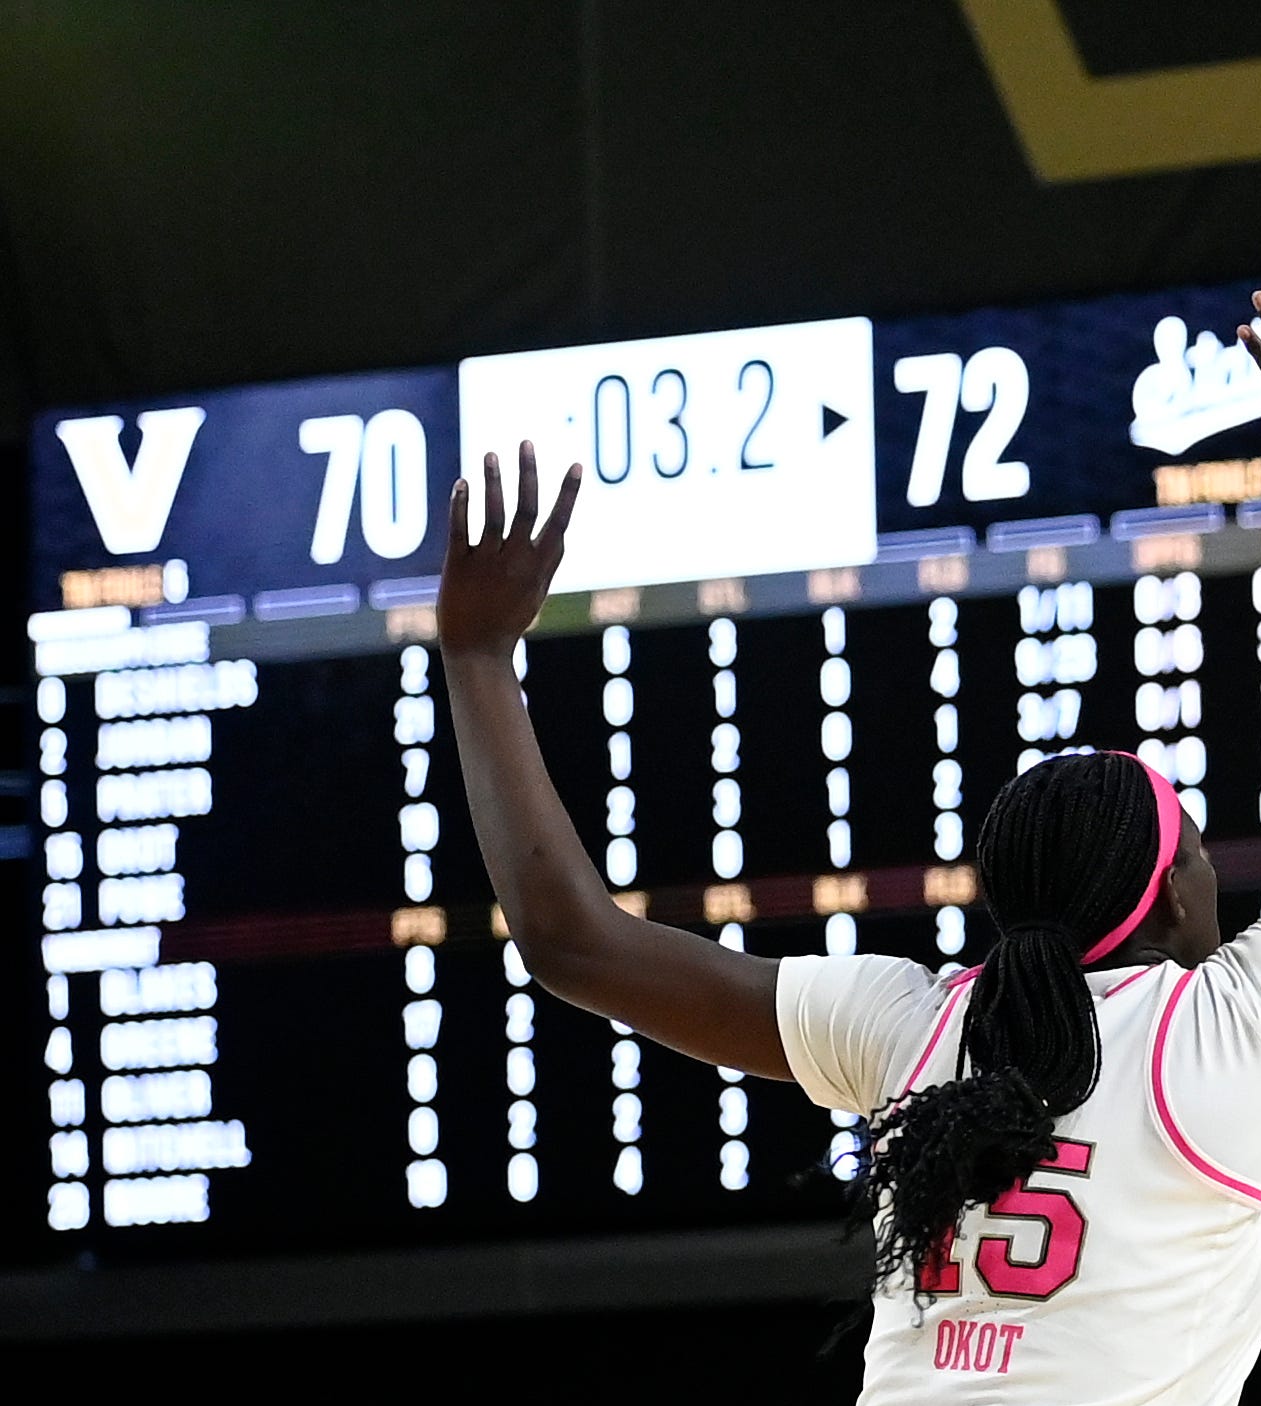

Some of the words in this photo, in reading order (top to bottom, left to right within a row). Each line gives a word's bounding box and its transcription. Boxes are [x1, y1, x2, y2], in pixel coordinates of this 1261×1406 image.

[56, 406, 206, 555] V
[299, 408, 428, 564] 70
[894, 347, 1031, 507] 72
[933, 1319, 1025, 1374] OKOT
